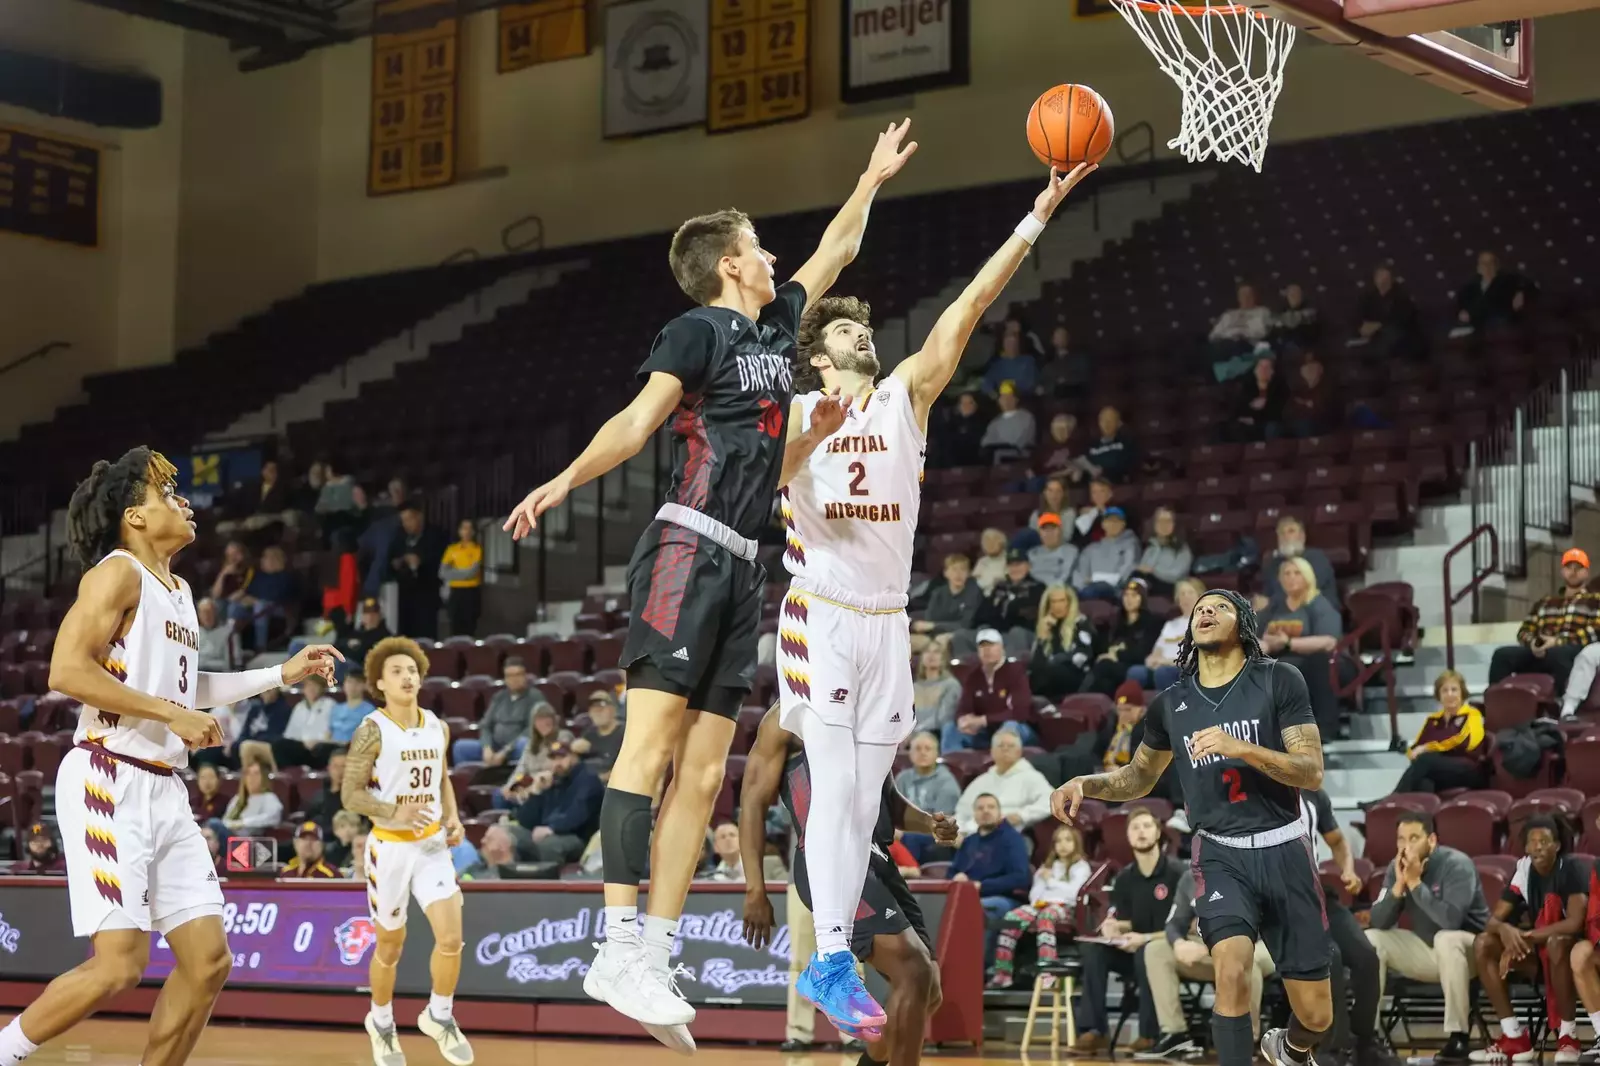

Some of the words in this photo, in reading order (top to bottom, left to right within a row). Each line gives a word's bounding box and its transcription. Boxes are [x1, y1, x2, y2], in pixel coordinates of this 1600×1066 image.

[852, 0, 948, 37] meijer
[848, 461, 869, 496] 2
[178, 655, 188, 693] 3
[410, 766, 432, 789] 30
[1222, 768, 1248, 804] 2
[293, 921, 314, 952] 0
[476, 908, 590, 965] Central
